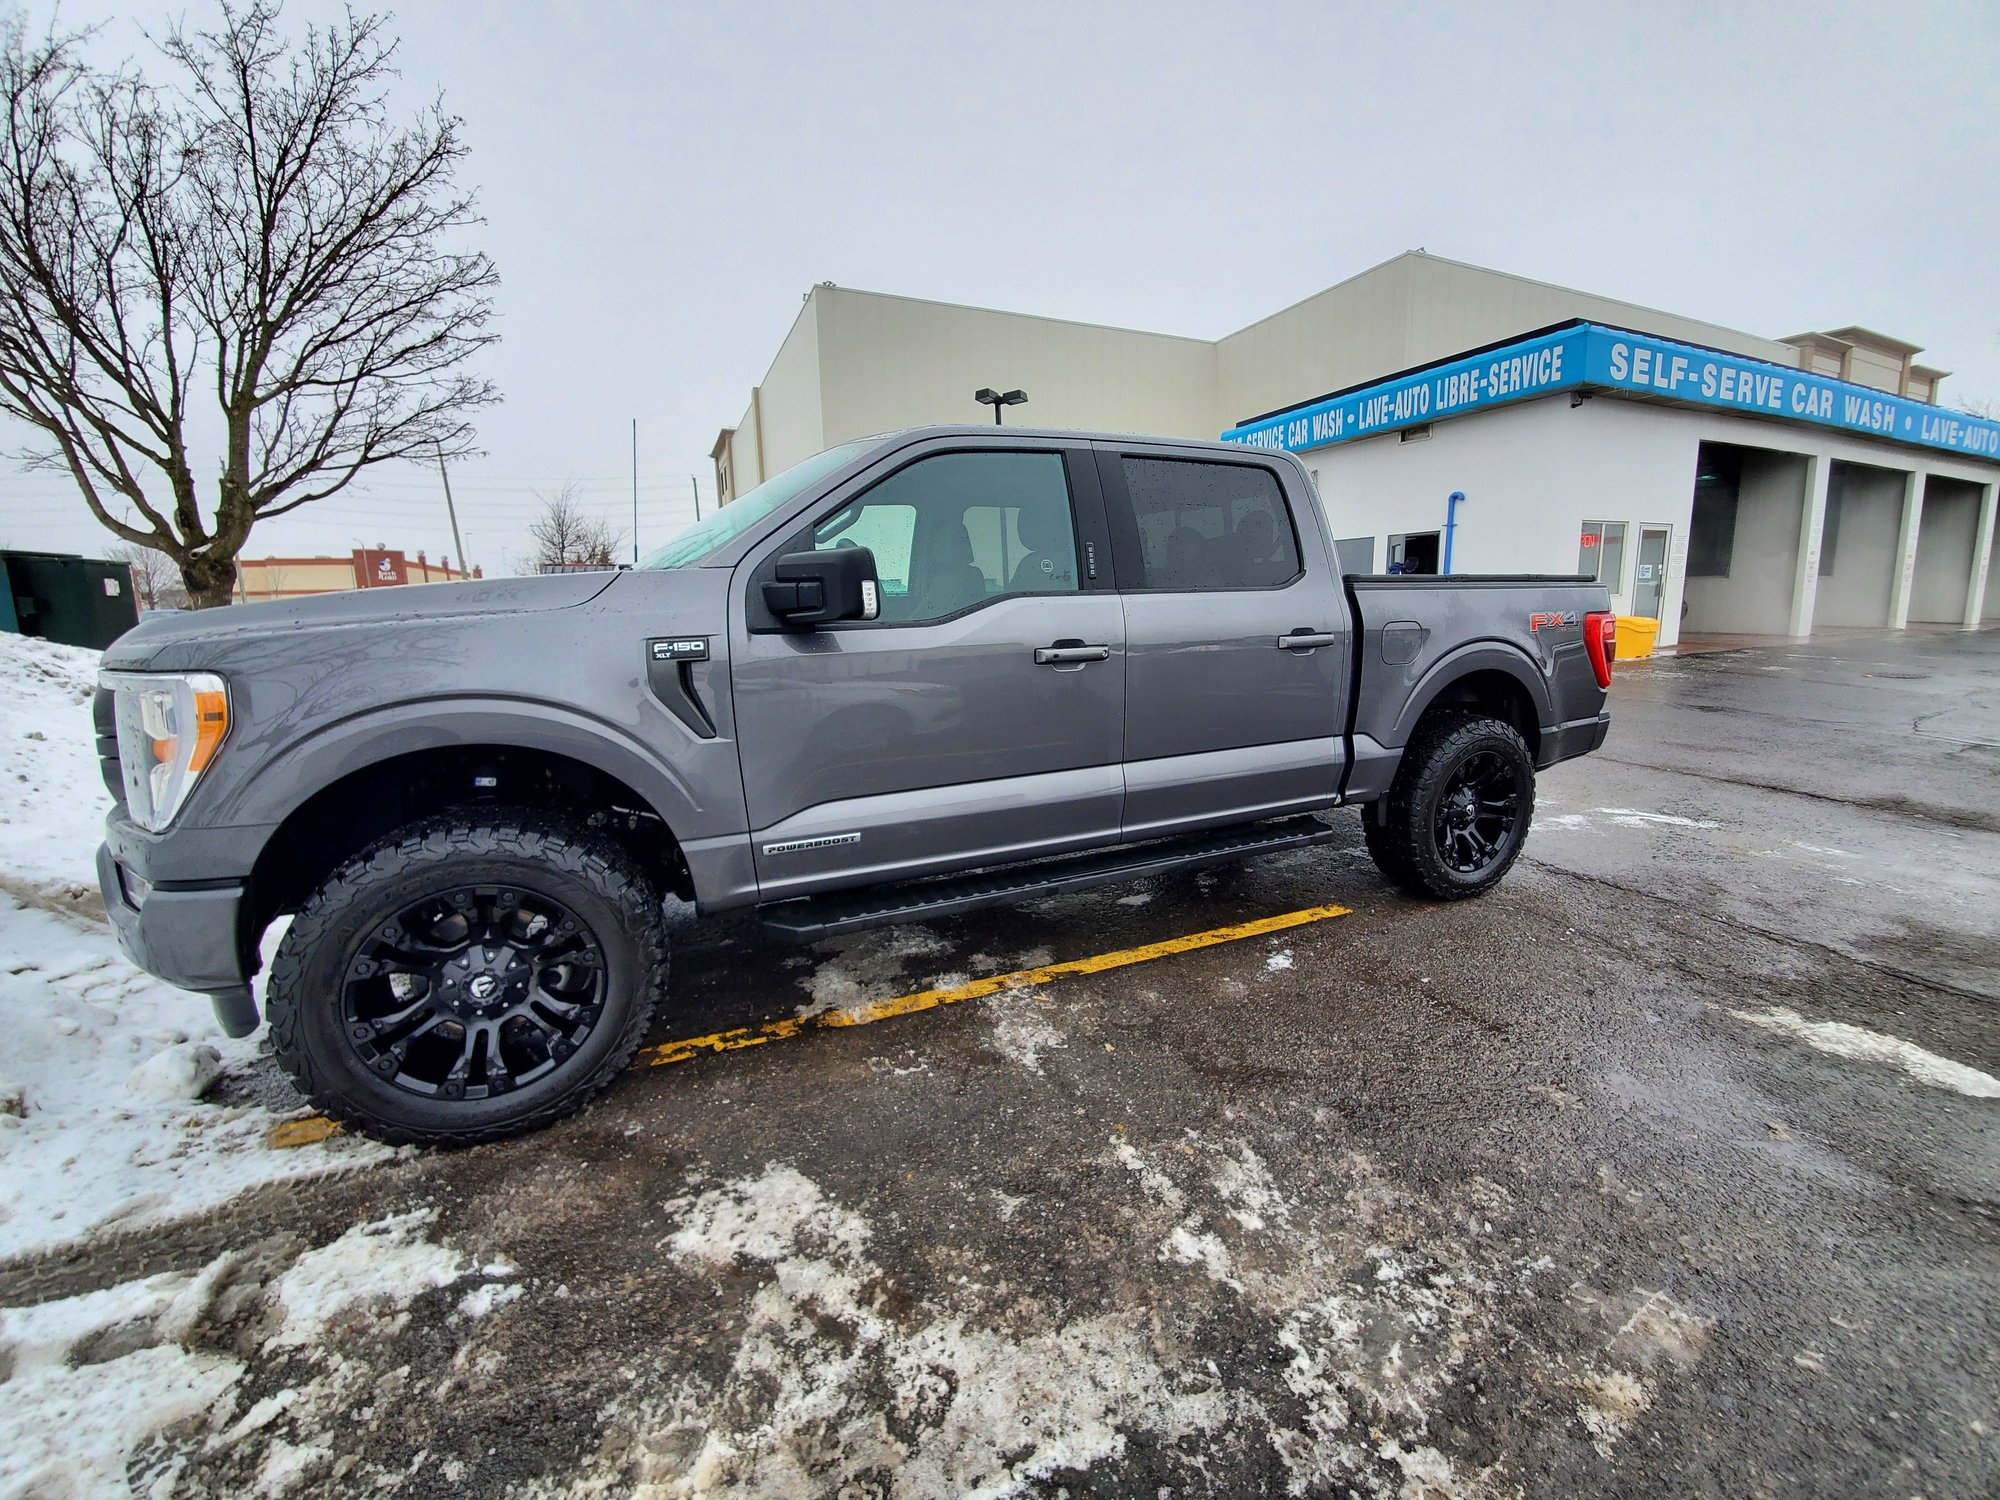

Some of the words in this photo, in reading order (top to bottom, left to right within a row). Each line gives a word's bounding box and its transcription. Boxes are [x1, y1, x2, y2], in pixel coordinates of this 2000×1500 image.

[1288, 418, 1309, 448] CAR
[1312, 408, 1344, 441] WASH
[1358, 383, 1429, 430] LAVE-AUTO
[1436, 345, 1564, 411] LIBRE-SERVICE
[1609, 343, 1784, 409] SELF-SERVE
[1791, 382, 1834, 419] CAR
[1844, 394, 1896, 432] WASH
[1921, 414, 1999, 454] LAVE-AUTO
[1580, 535, 1595, 548] PEN
[1529, 610, 1579, 633] FX4
[653, 641, 705, 653] F-150
[767, 835, 857, 854] POWERBOOST
